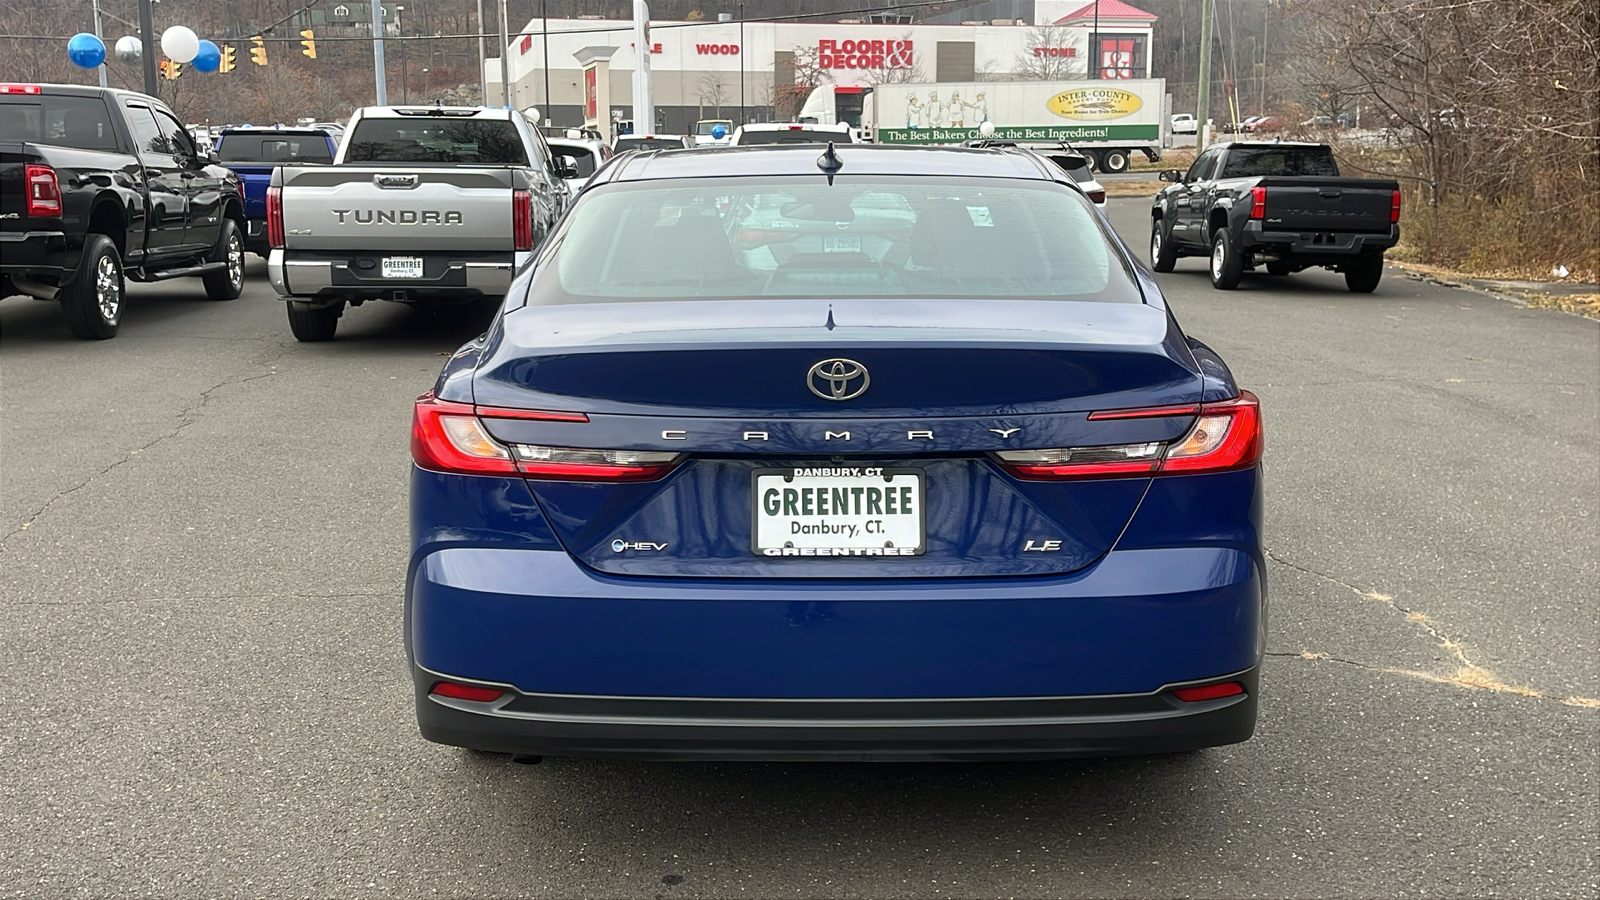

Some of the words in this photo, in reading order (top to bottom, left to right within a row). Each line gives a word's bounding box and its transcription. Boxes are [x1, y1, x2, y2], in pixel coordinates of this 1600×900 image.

[696, 44, 740, 54] WOOD
[819, 39, 884, 54] FLOOR
[1033, 47, 1077, 57] STONE
[819, 54, 884, 70] DECOR
[888, 131, 907, 140] The
[910, 131, 930, 140] Best
[933, 130, 965, 140] Bakers
[1006, 129, 1022, 139] the
[1025, 128, 1045, 138] Best
[1049, 127, 1109, 140] Ingredients!
[331, 209, 464, 226] TUNDRA
[383, 260, 421, 269] GREENTREE
[661, 428, 1021, 441] CAMRY
[793, 468, 861, 478] DANBURY,
[865, 467, 883, 477] CT
[763, 487, 913, 517] GREENTREE
[791, 519, 860, 538] Danbury,
[865, 520, 885, 534] CT.
[763, 547, 915, 556] GREENTREE
[1024, 540, 1062, 552] LE
